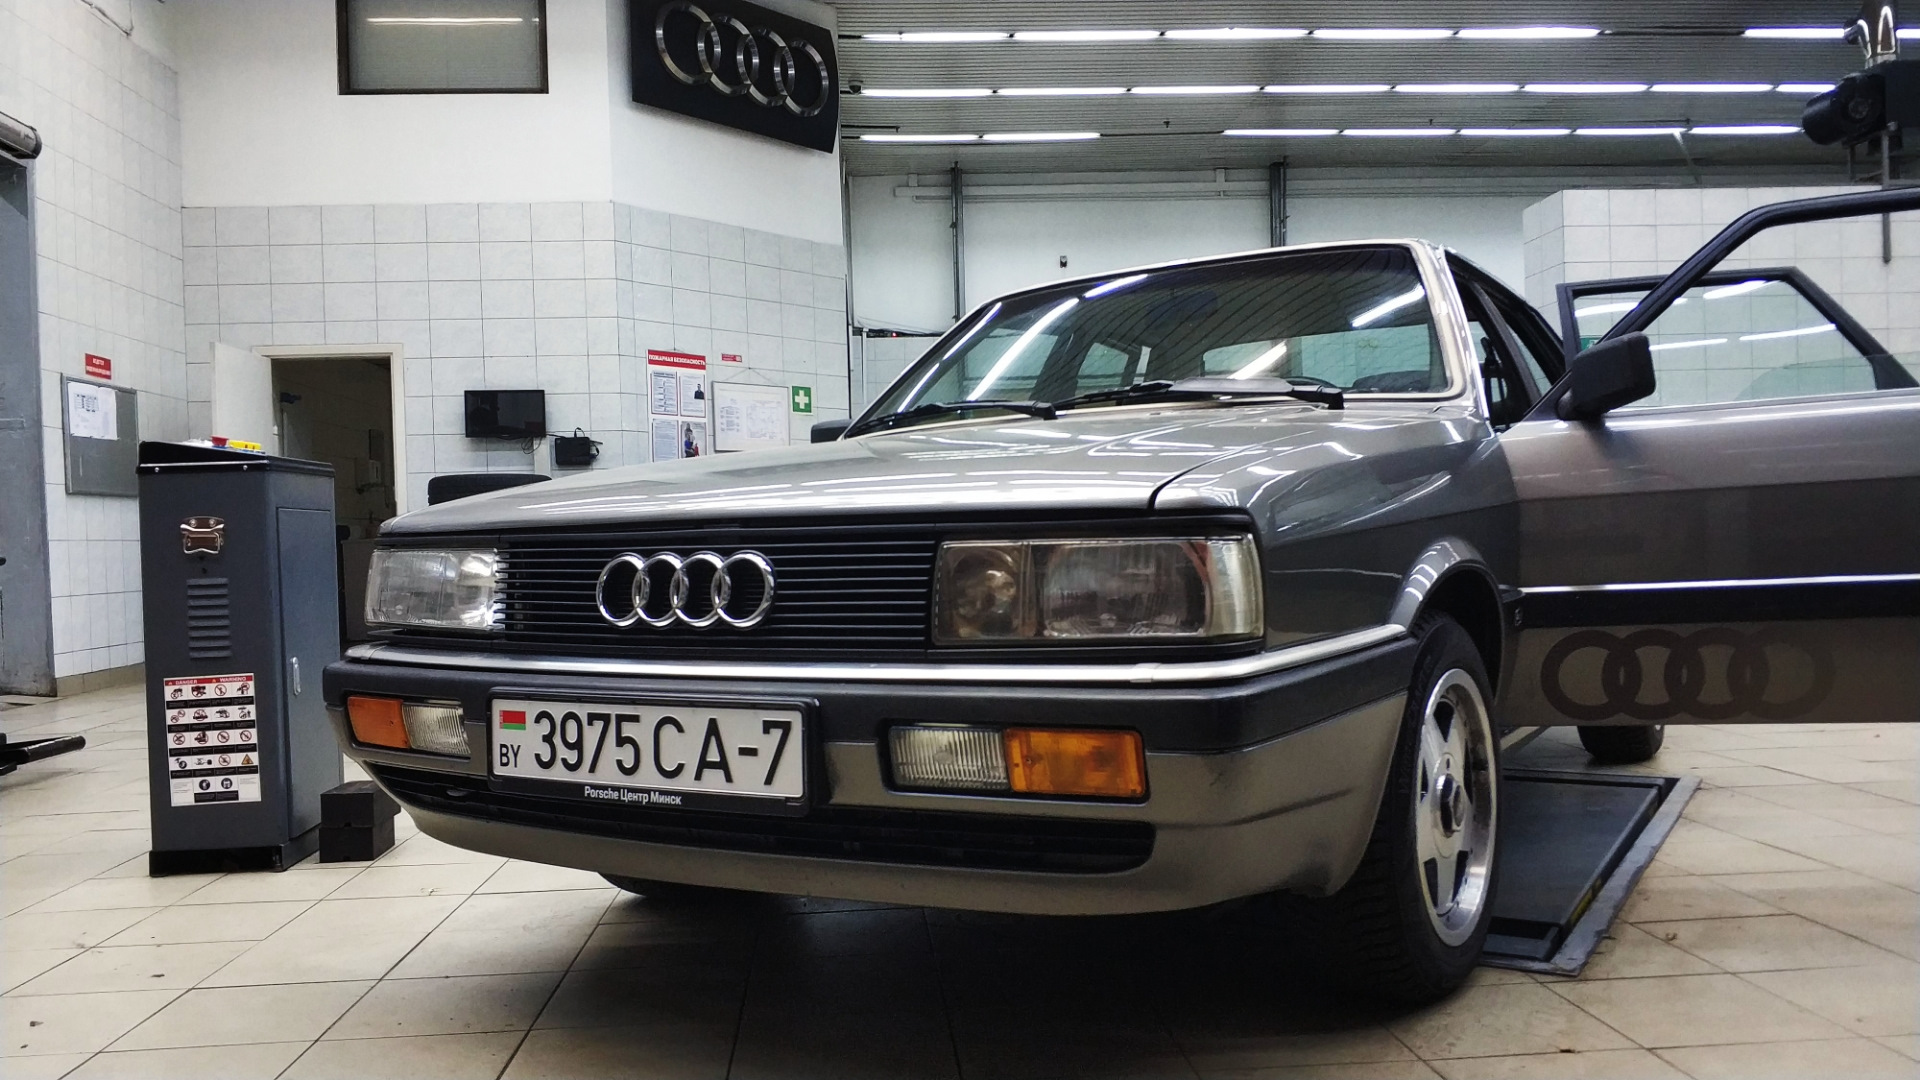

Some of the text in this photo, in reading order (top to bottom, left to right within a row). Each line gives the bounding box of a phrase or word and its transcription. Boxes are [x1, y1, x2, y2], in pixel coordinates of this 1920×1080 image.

[499, 743, 521, 768] BY
[584, 785, 682, 805] Porsche Центр Минск
